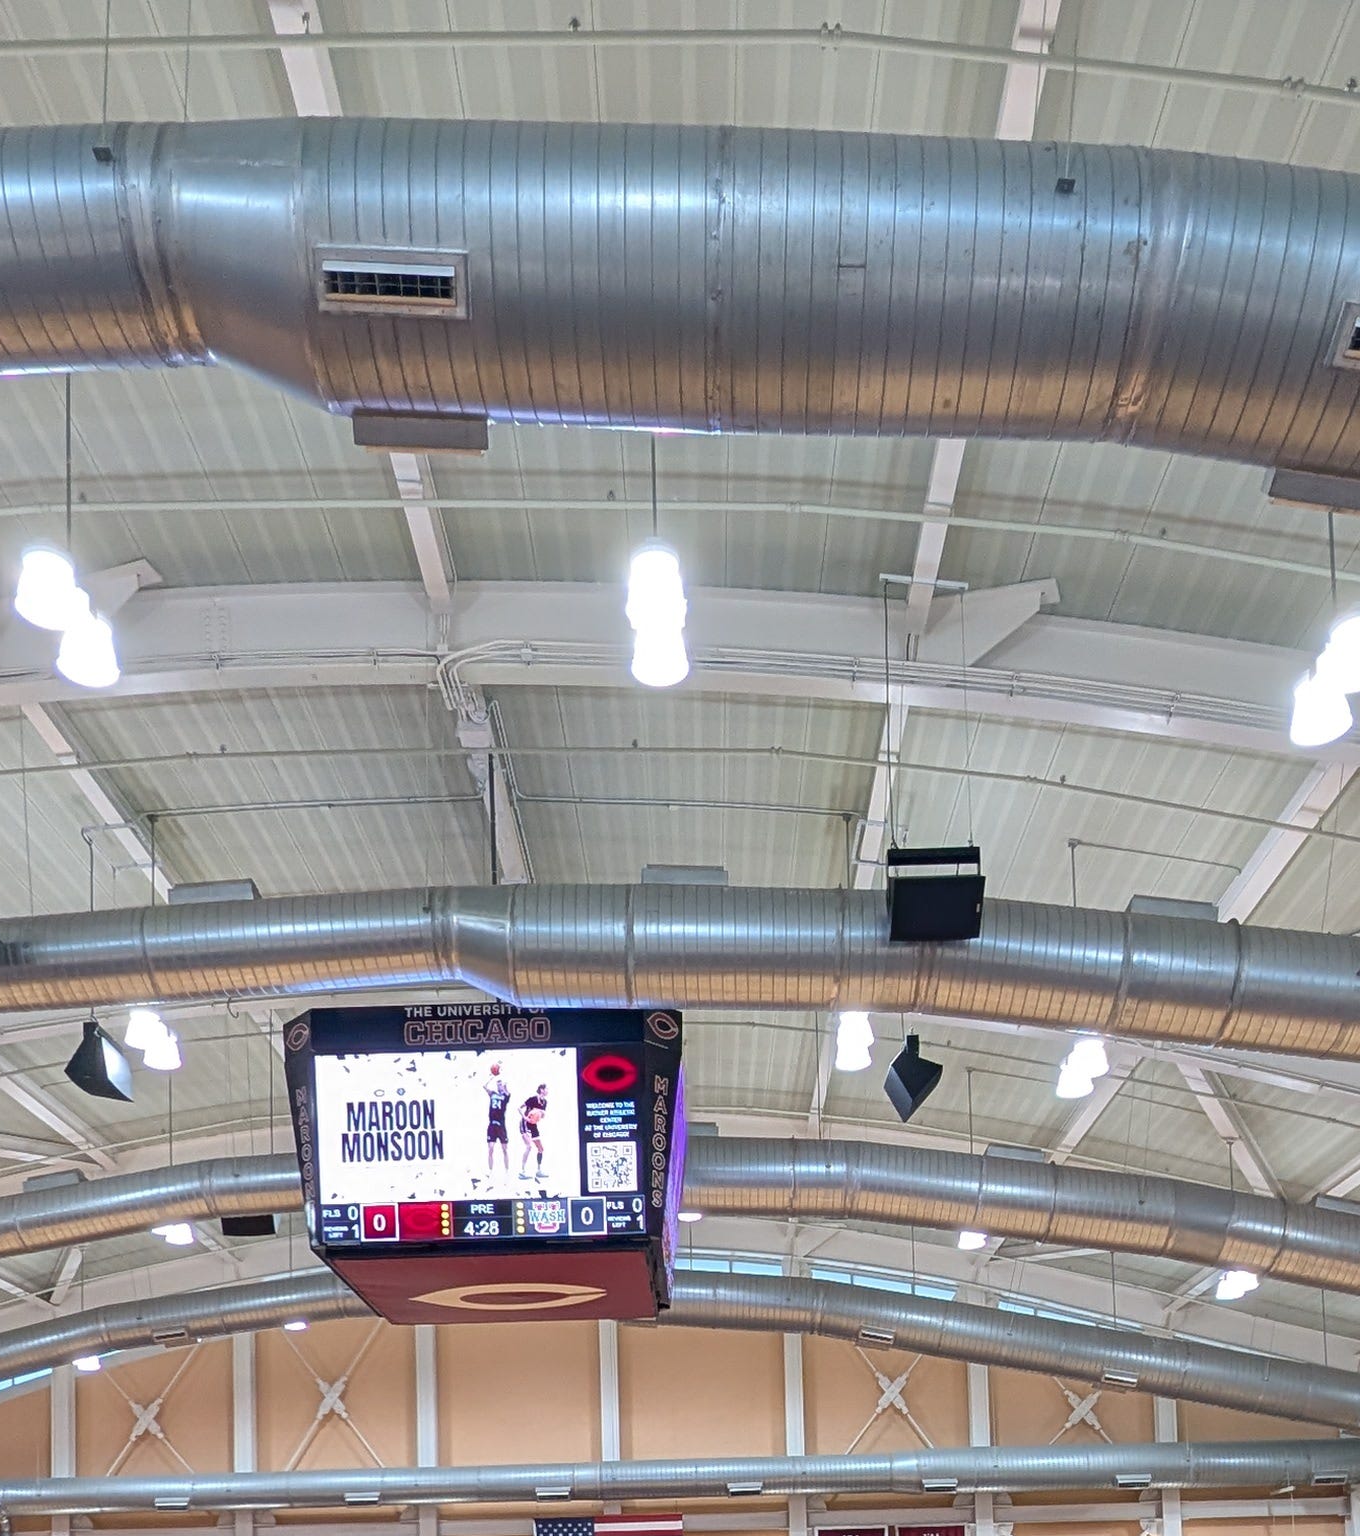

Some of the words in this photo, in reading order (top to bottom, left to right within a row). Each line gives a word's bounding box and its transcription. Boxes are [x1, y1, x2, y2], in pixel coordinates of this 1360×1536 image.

[404, 1006, 433, 1018] THE
[404, 1017, 551, 1045] CHICAGO
[346, 1100, 436, 1132] MAROON
[341, 1131, 444, 1163] MONSOON
[651, 1075, 669, 1208] MAROONS
[348, 1205, 358, 1221] 0
[471, 1204, 494, 1214] PRE
[632, 1198, 643, 1213] 0
[373, 1214, 386, 1231] 0
[528, 1209, 566, 1224] WASH
[581, 1207, 594, 1225] 0
[464, 1220, 500, 1236] 4:28
